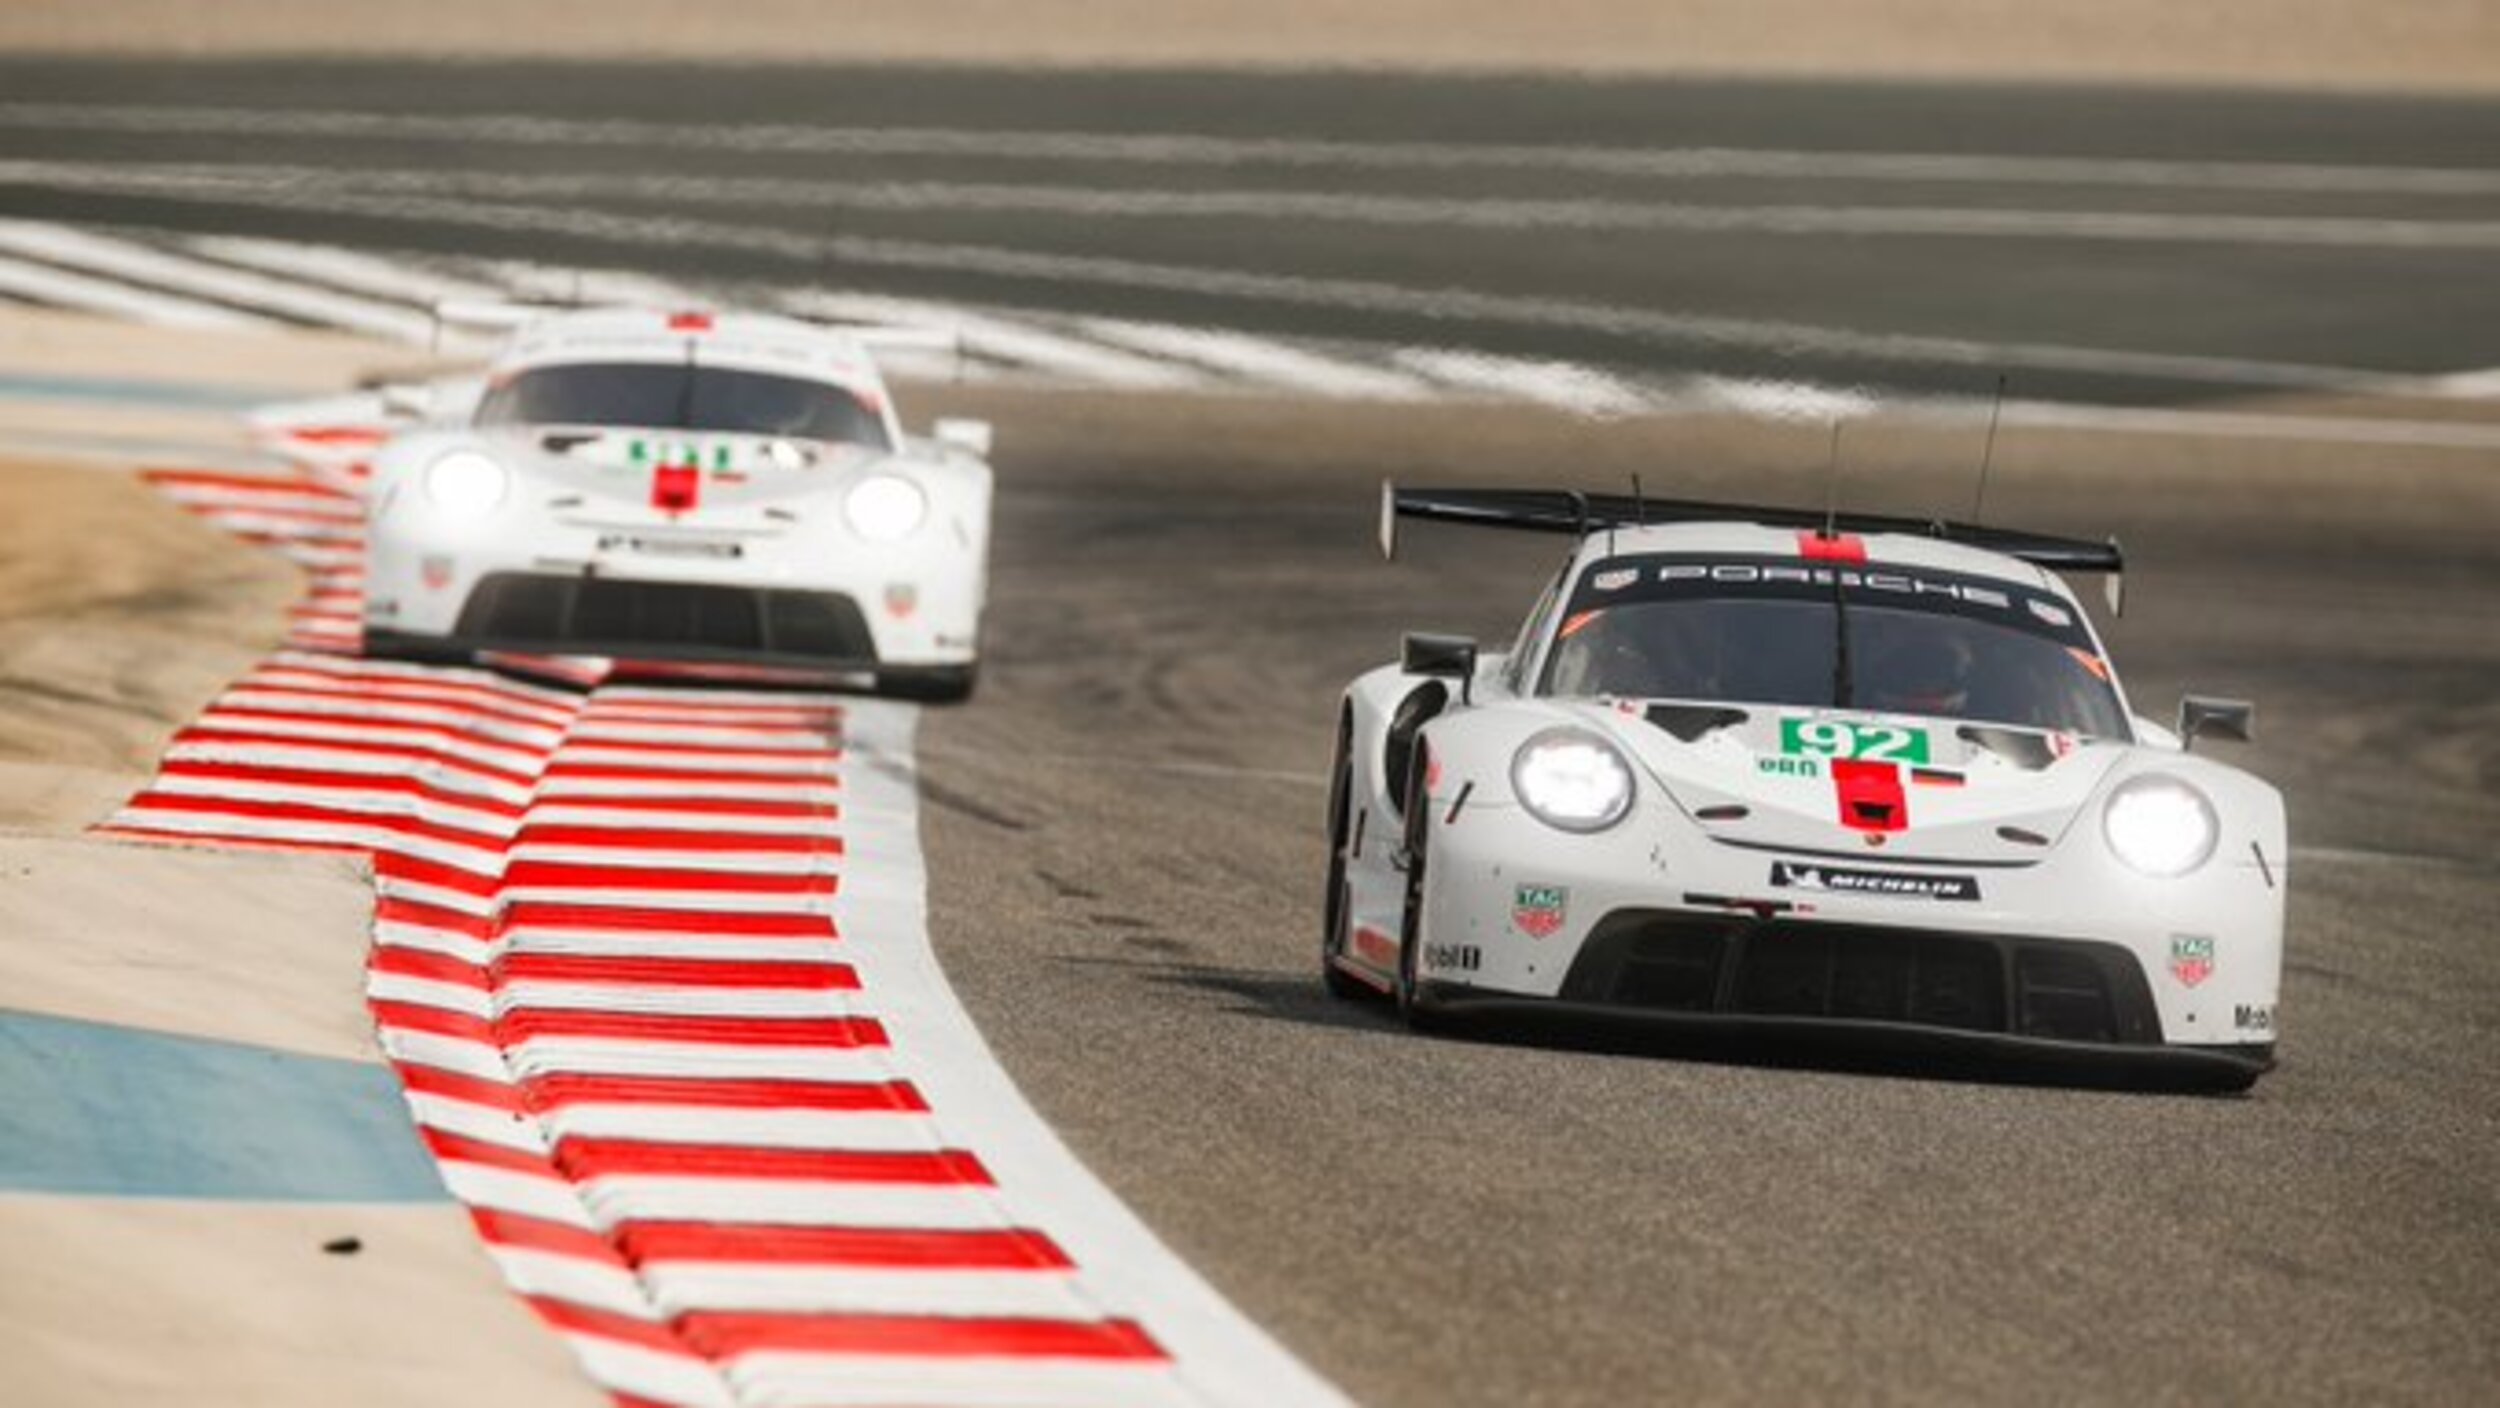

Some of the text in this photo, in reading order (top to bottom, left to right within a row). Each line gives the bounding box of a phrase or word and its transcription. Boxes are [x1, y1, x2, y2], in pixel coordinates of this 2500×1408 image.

[1660, 565, 2010, 608] PORSCHE
[1797, 722, 1912, 760] 92
[1829, 874, 1962, 895] MICHELIN
